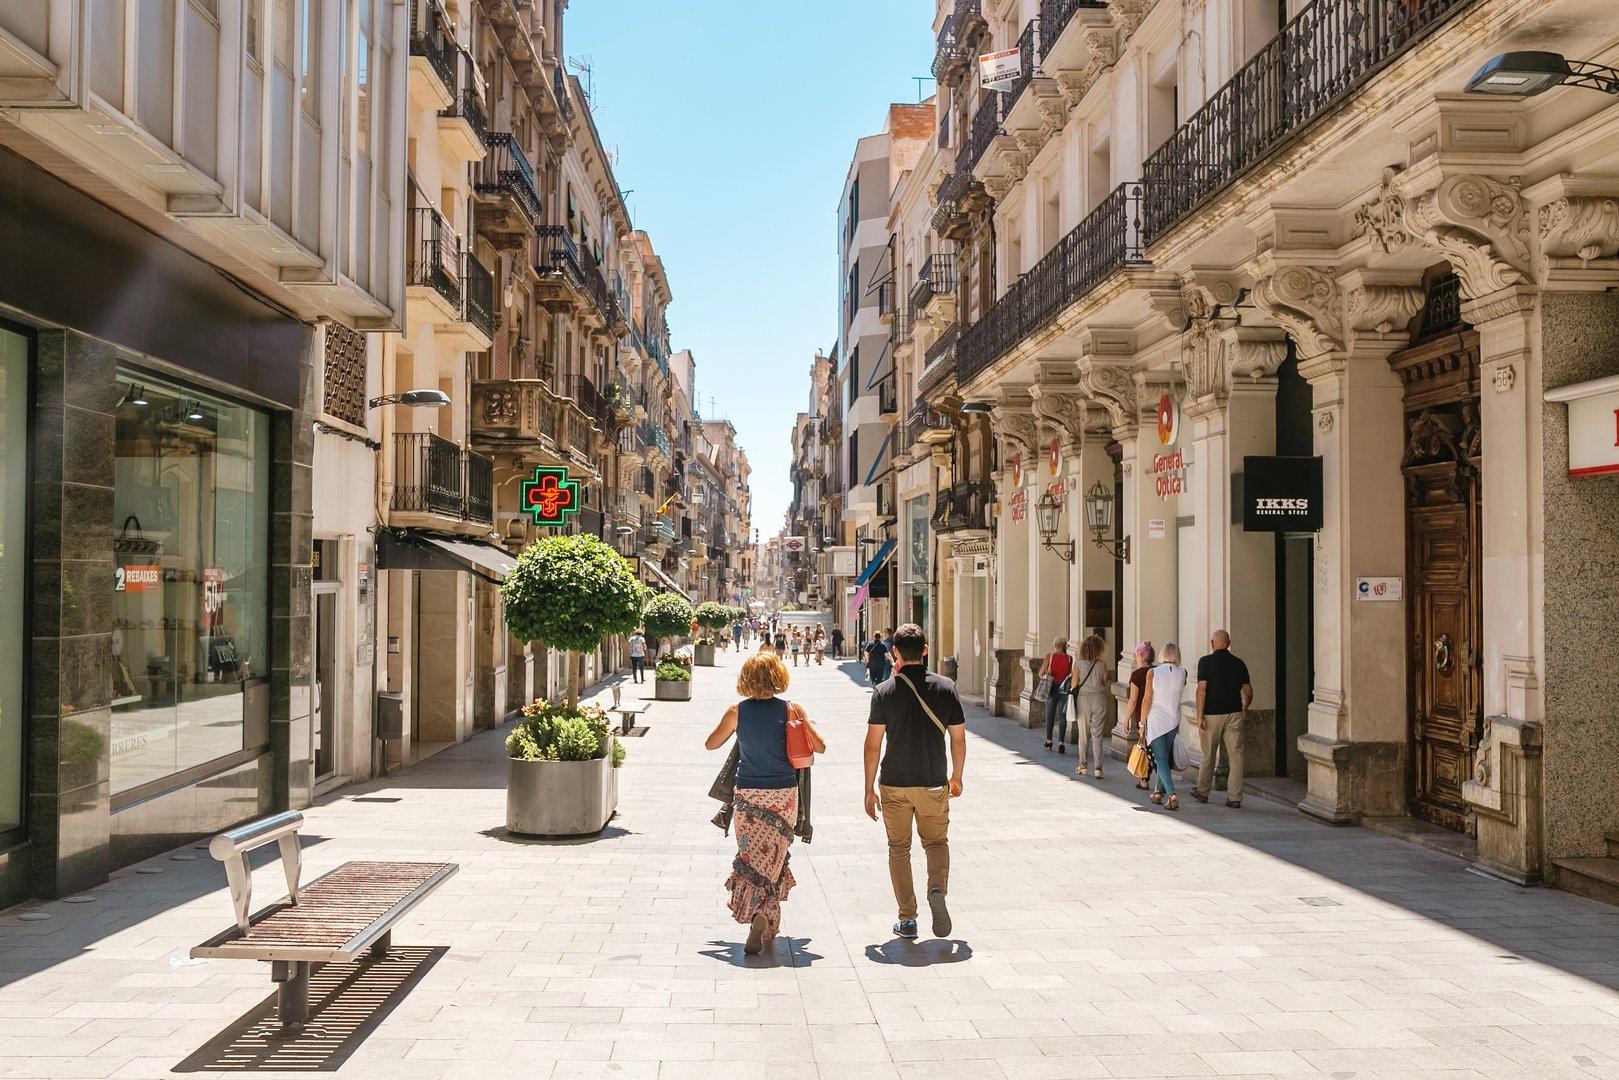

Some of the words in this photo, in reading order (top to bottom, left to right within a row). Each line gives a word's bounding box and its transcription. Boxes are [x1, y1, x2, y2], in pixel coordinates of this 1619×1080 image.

[1497, 370, 1507, 387] 56
[1153, 448, 1183, 473] General
[1156, 474, 1181, 501] Optica
[1256, 498, 1308, 509] IKKS
[126, 570, 158, 582] REBAIXES
